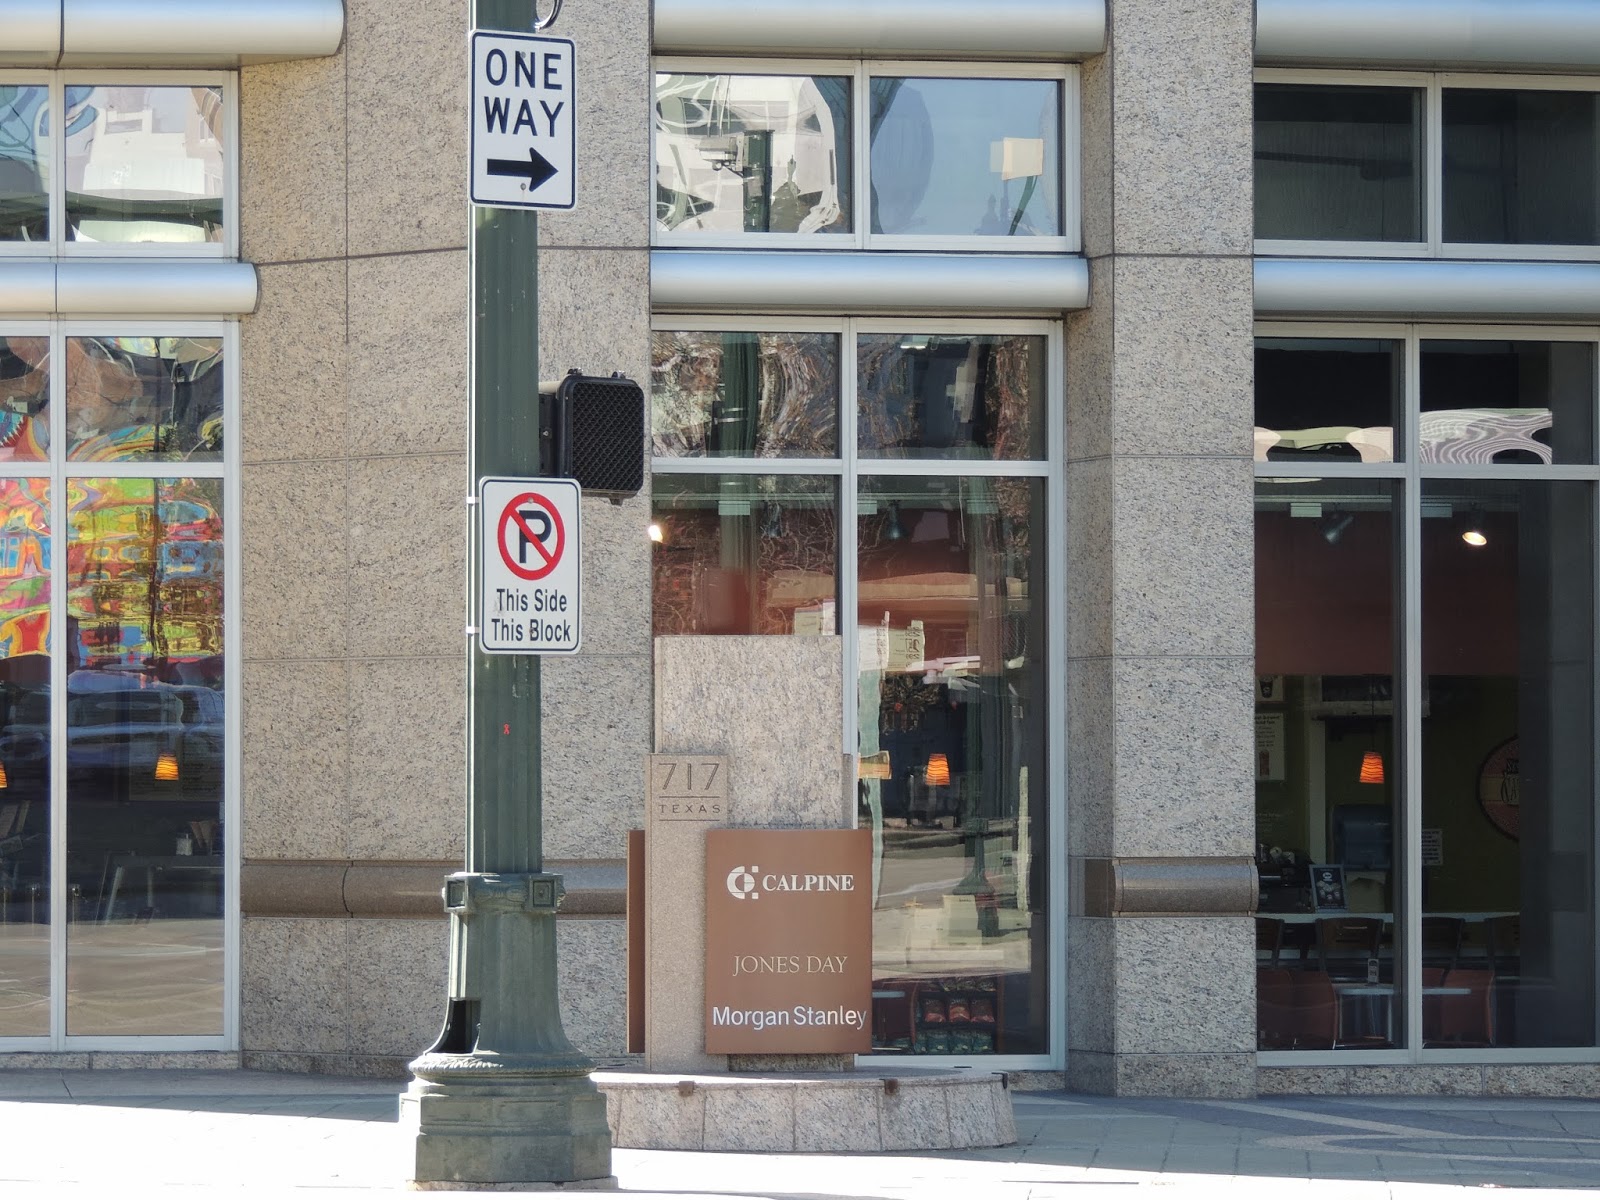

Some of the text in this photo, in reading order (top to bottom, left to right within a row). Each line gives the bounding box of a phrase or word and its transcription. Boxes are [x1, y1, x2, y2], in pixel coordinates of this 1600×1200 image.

[486, 48, 562, 90] ONE
[484, 96, 565, 137] WAY
[496, 588, 567, 612] This Side
[491, 618, 571, 642] This Block
[658, 763, 720, 790] 717
[658, 804, 721, 814] TEXAS
[762, 874, 854, 892] CALPINE
[732, 955, 848, 977] JONES DAY
[712, 1005, 867, 1031] Morgan Stanley
